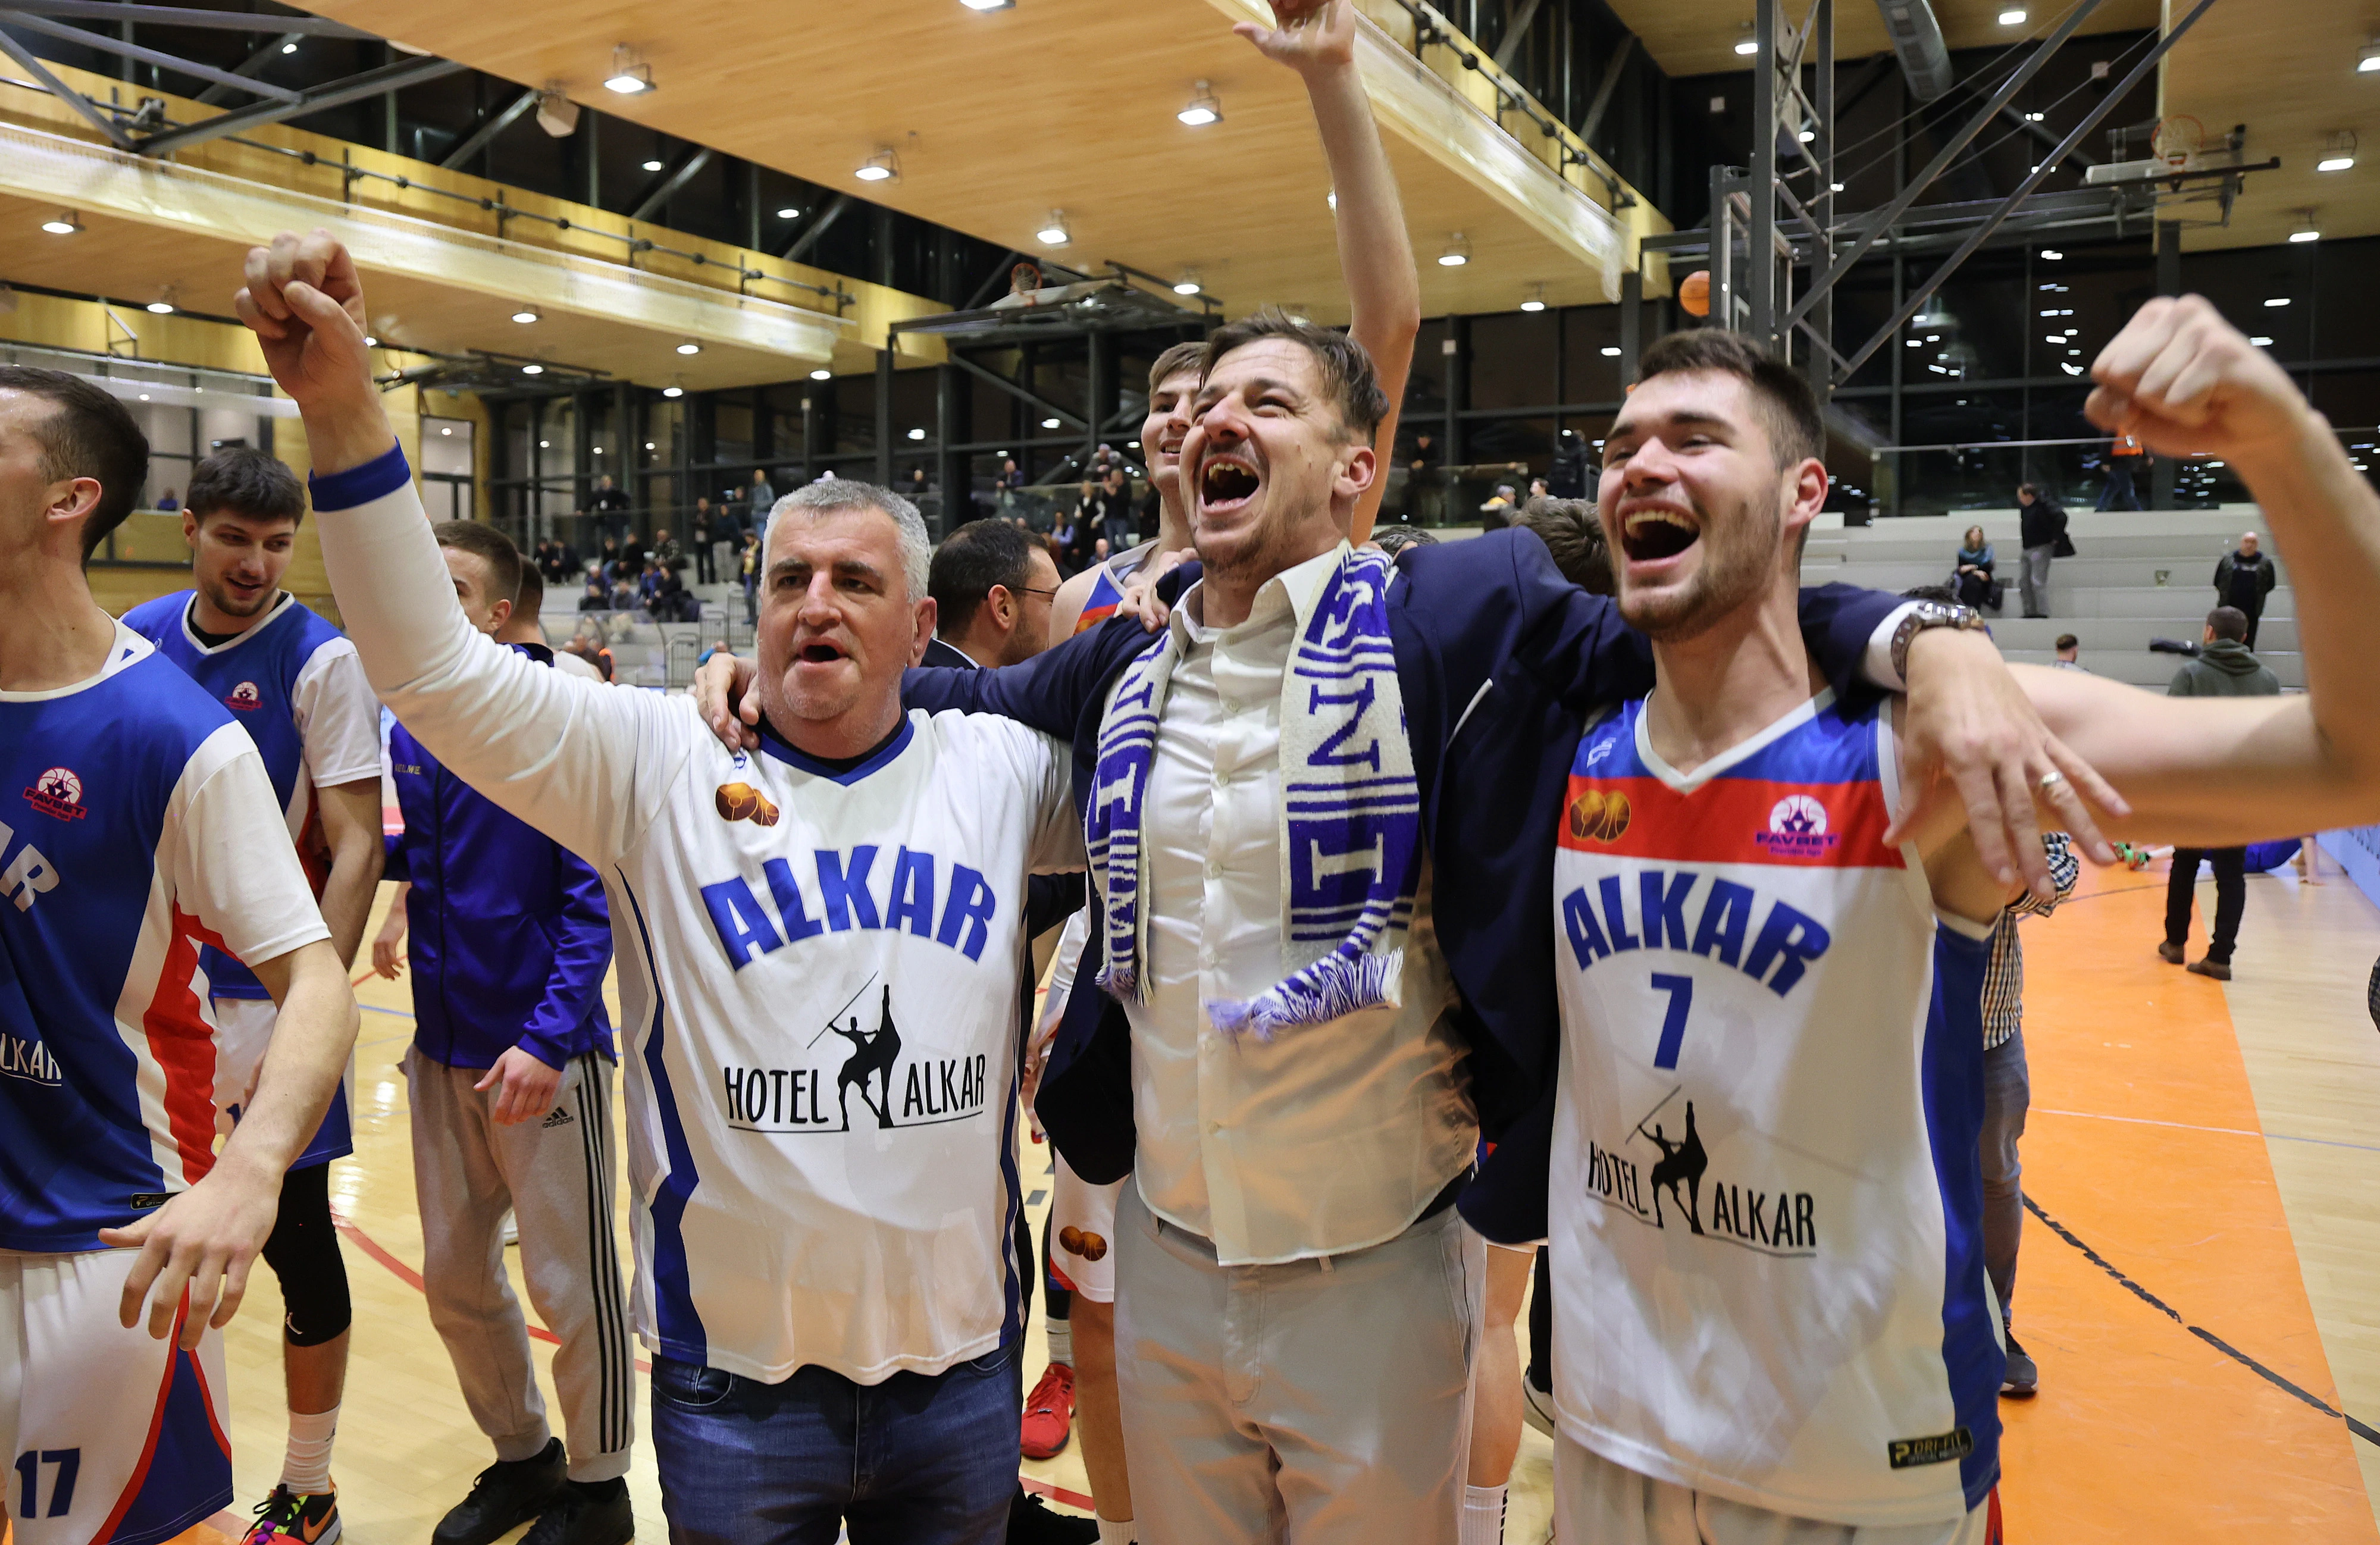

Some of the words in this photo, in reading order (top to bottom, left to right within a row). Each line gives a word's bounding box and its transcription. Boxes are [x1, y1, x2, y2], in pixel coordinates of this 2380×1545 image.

[25, 789, 84, 816] FAVBET
[1756, 833, 1837, 845] FAVBET
[699, 844, 996, 973] ALKAR
[1562, 871, 1831, 998] ALKAR
[1651, 972, 1693, 1070] 7
[542, 1116, 574, 1129] adidas
[724, 1067, 829, 1124] HOTEL
[903, 1054, 986, 1117] ALKAR
[1587, 1140, 1649, 1215] HOTEL
[1714, 1182, 1816, 1247] ALKAR
[15, 1447, 80, 1518] 17
